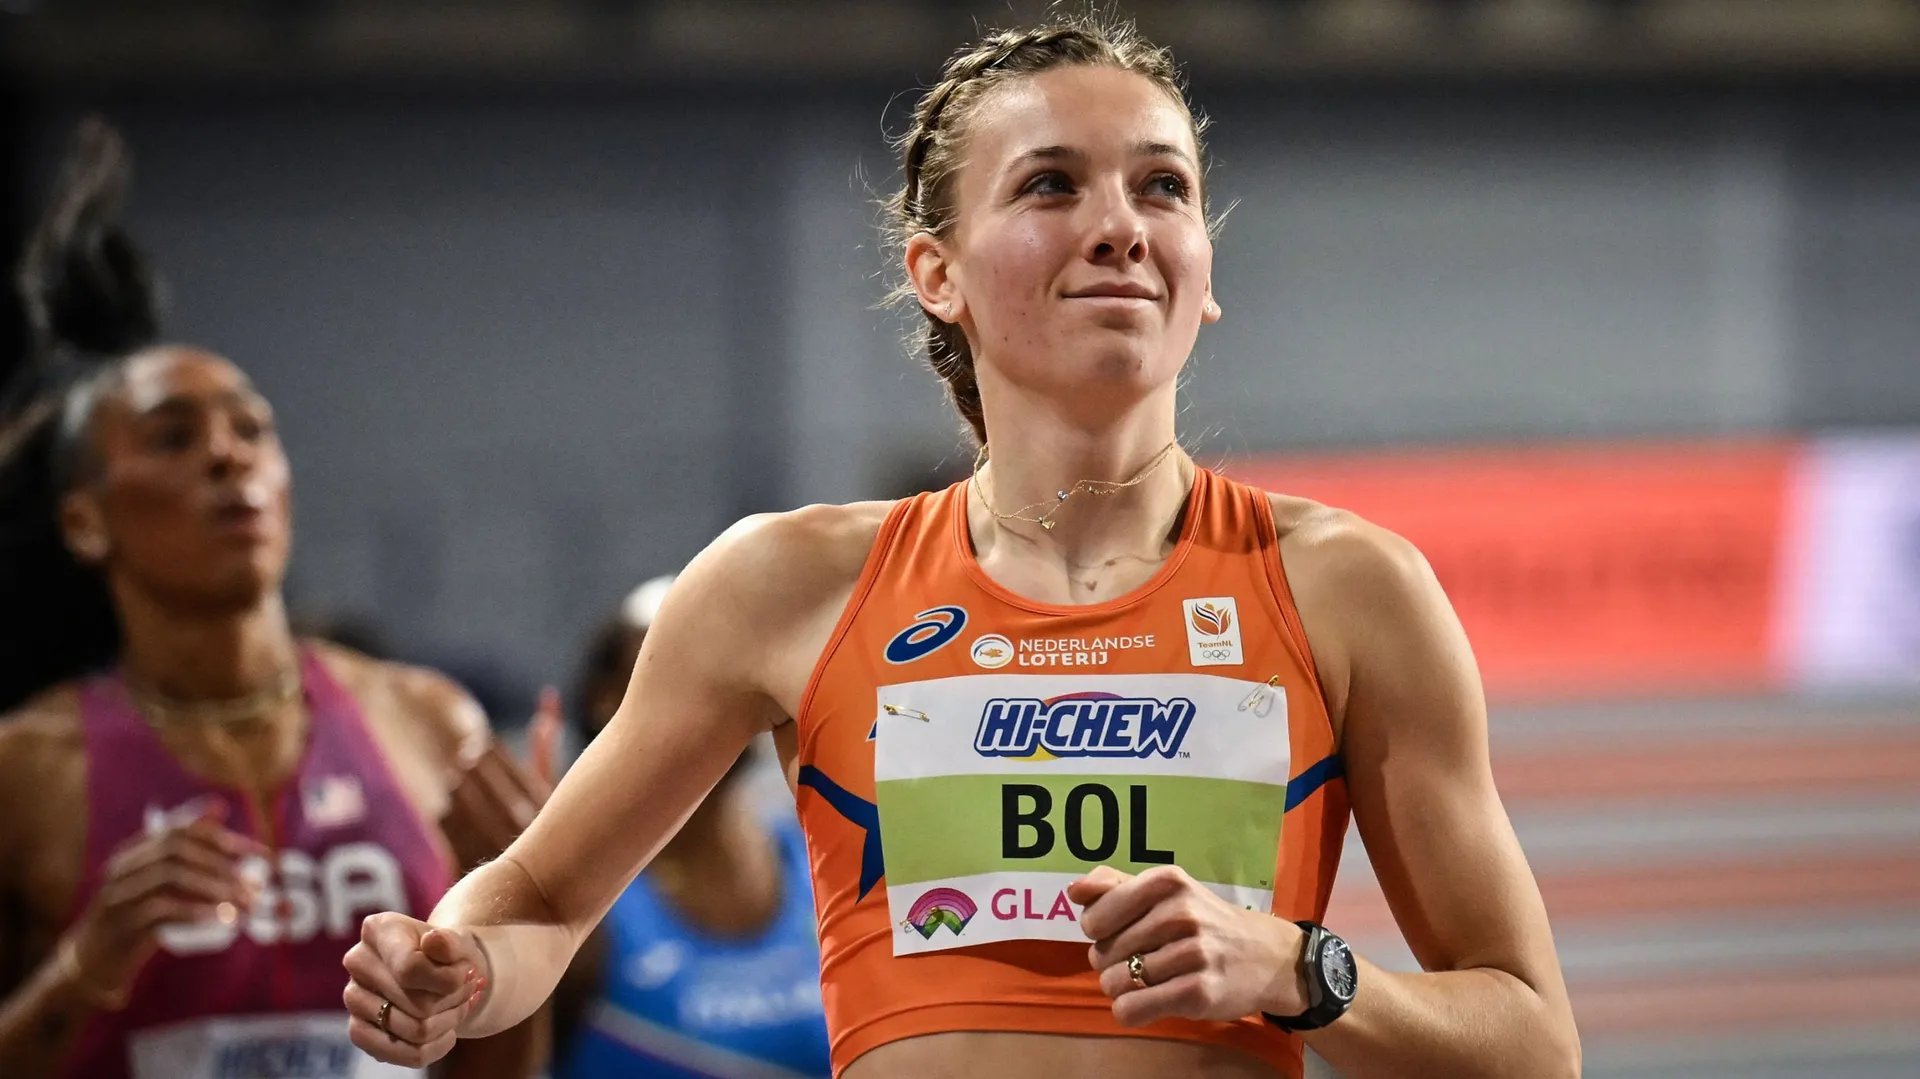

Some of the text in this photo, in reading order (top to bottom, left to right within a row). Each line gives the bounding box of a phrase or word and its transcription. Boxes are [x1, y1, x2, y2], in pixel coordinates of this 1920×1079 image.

[1019, 635, 1155, 653] NEDERLANDSE
[1197, 640, 1234, 649] TeamNL
[1018, 651, 1108, 667] LOTERIJ
[974, 698, 1196, 759] HI-CHEW
[1002, 783, 1175, 865] BOL
[991, 887, 1077, 922] GLA
